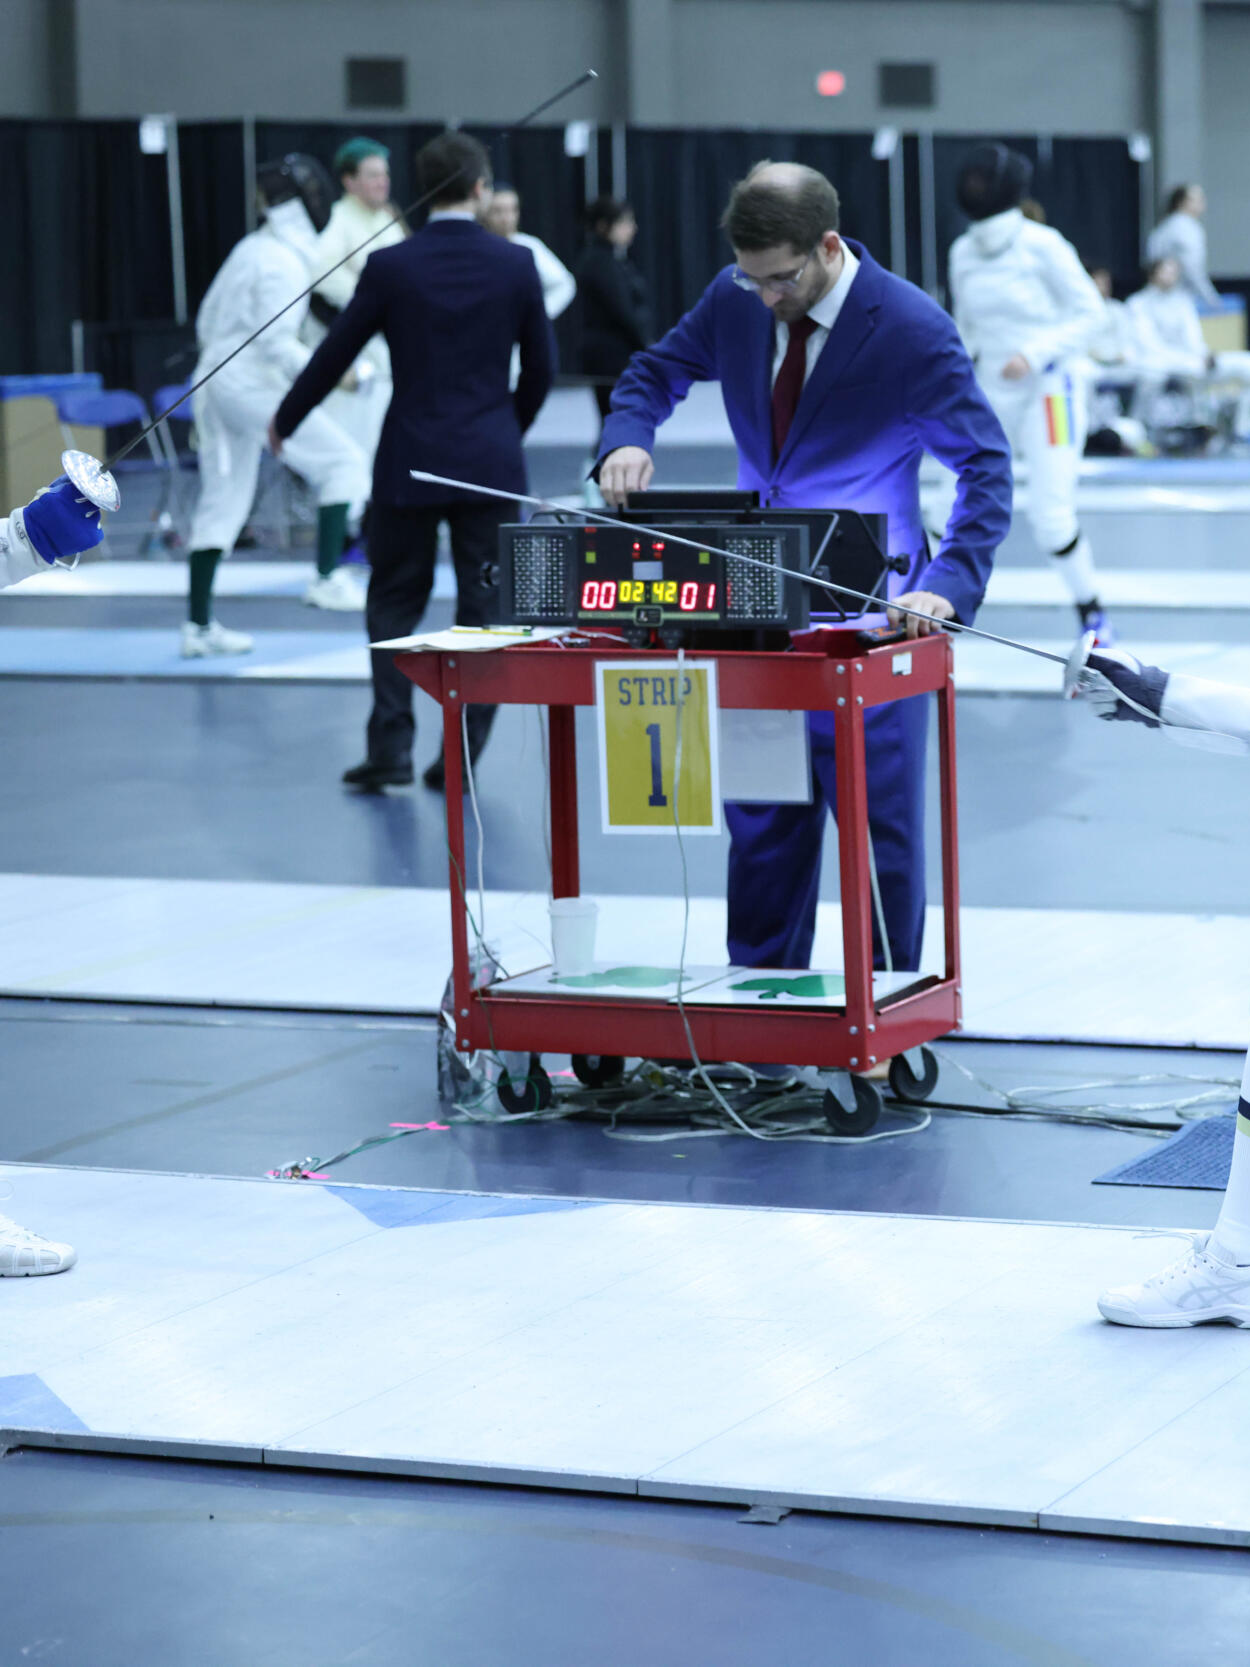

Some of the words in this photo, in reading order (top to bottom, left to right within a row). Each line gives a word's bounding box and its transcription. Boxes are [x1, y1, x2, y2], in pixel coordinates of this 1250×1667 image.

[581, 580, 617, 610] 00
[680, 582, 716, 610] 01
[618, 677, 692, 706] STRIP
[645, 723, 668, 807] 1
